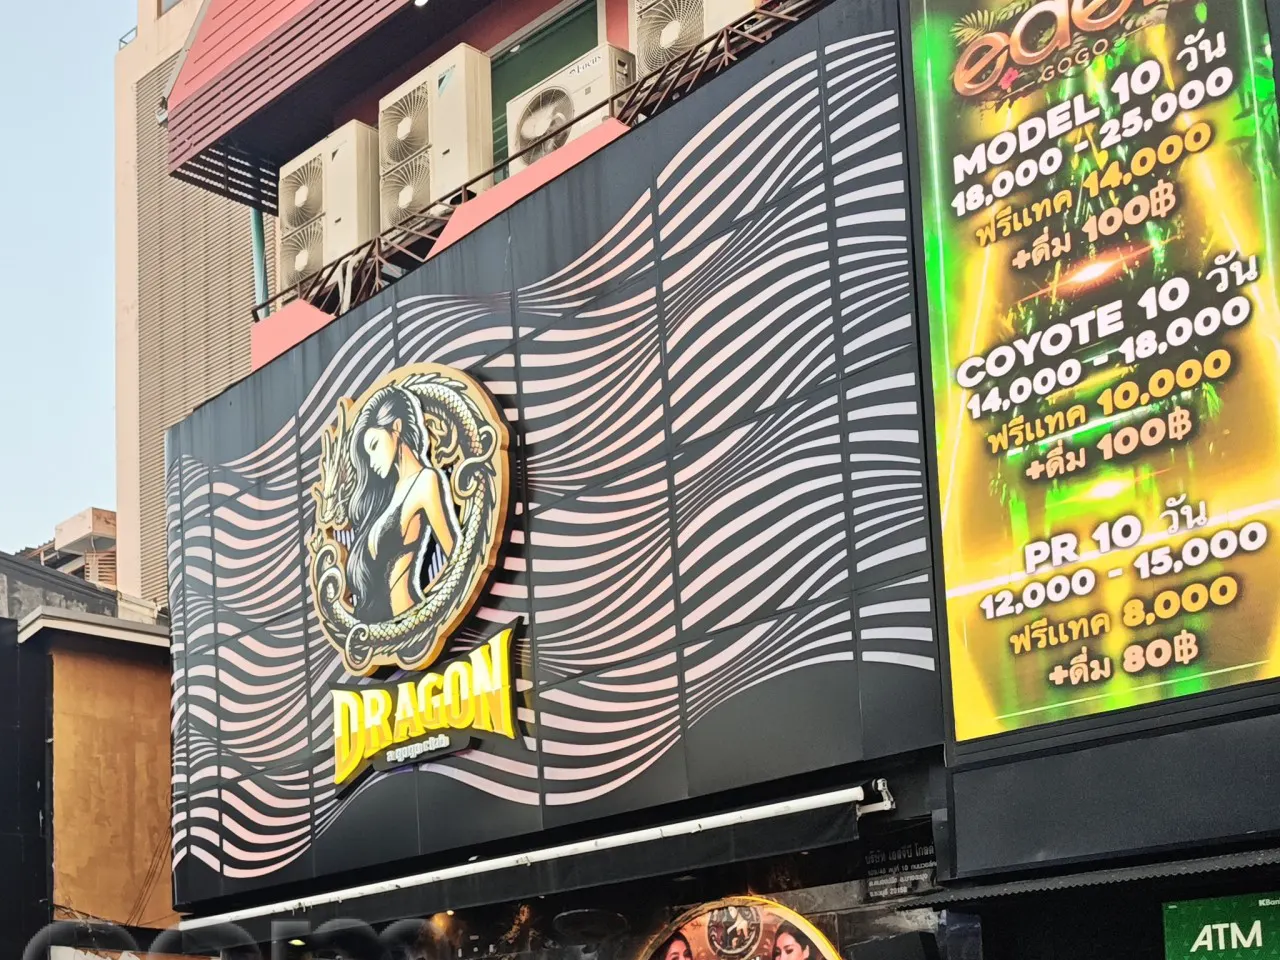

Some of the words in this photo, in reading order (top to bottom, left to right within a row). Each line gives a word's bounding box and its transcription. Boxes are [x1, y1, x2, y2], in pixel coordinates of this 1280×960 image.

[1041, 38, 1109, 82] GOGO
[953, 94, 1100, 185] MODEL
[1110, 59, 1161, 105] 10
[1176, 28, 1227, 73] วัน
[956, 300, 1125, 389] COYOTE
[1138, 276, 1190, 320] 10
[1205, 250, 1260, 293] วัน
[1023, 532, 1081, 575] PR
[1091, 514, 1142, 554] 10
[1158, 492, 1208, 535] วัน
[331, 627, 518, 785] DRAGON
[1189, 920, 1263, 953] ATM
[1258, 898, 1280, 907] KBan
